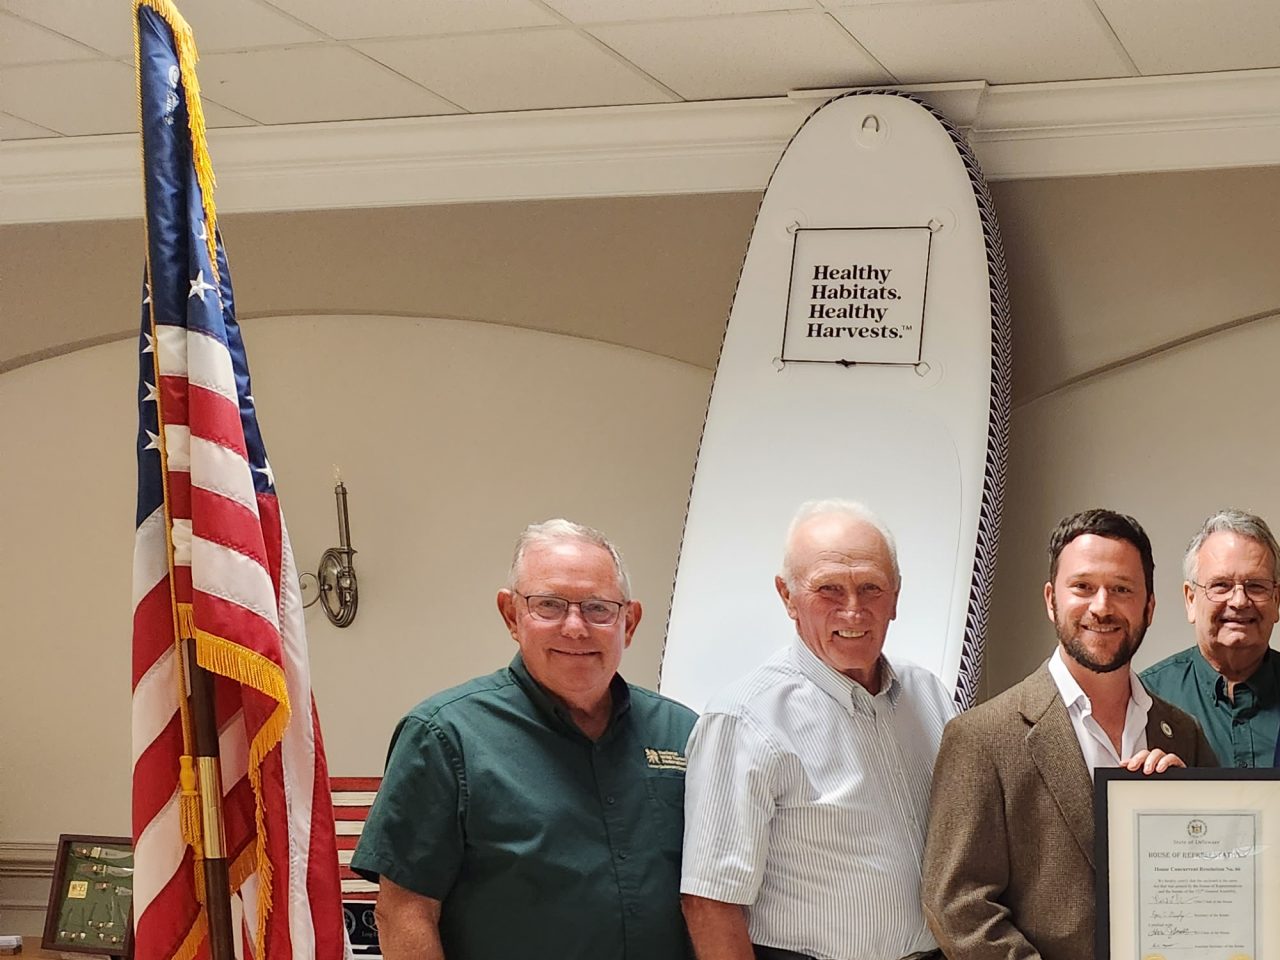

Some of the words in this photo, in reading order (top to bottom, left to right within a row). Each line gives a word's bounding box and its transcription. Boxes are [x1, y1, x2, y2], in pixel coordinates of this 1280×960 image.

[812, 264, 893, 285] Healthy
[810, 283, 902, 300] Habitats.
[808, 303, 889, 323] Healthy
